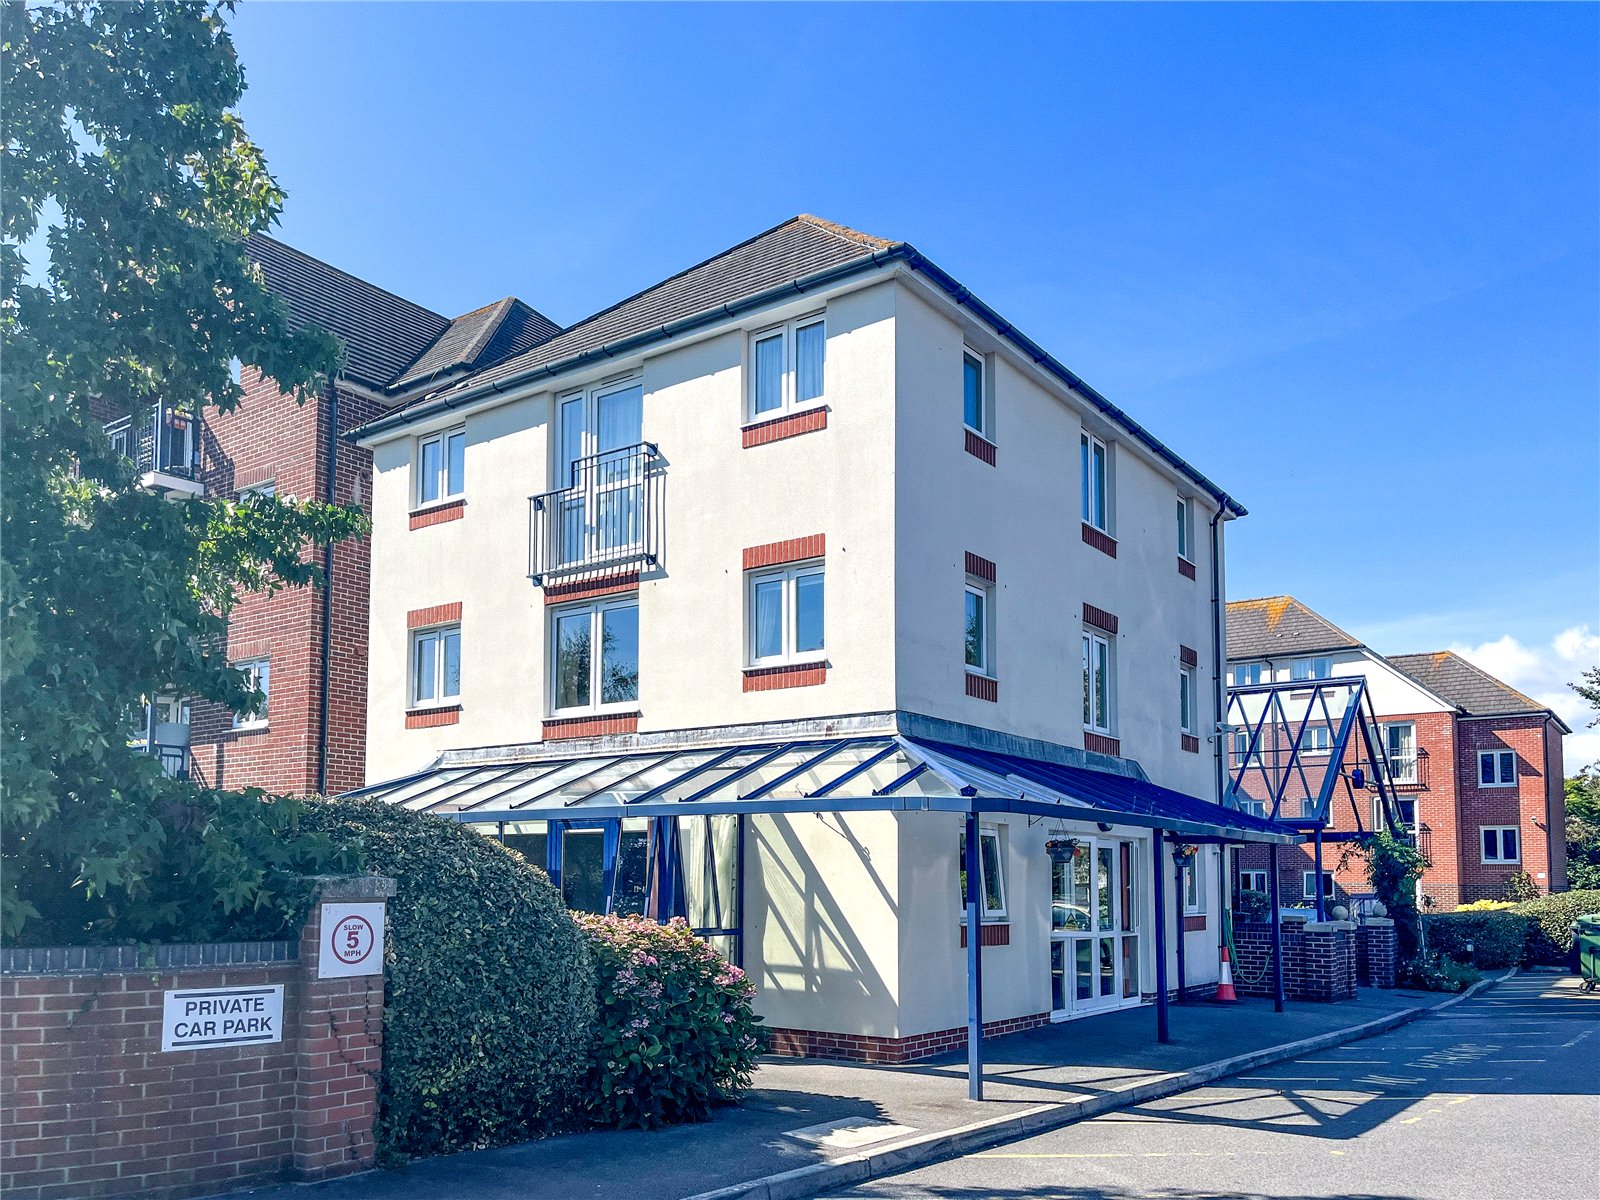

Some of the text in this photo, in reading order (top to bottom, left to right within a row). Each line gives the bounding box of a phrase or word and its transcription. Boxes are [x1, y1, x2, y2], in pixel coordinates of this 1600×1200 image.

[346, 930, 360, 949] 5
[185, 997, 265, 1017] PRIVATE
[174, 1016, 273, 1038] CAR PARK
